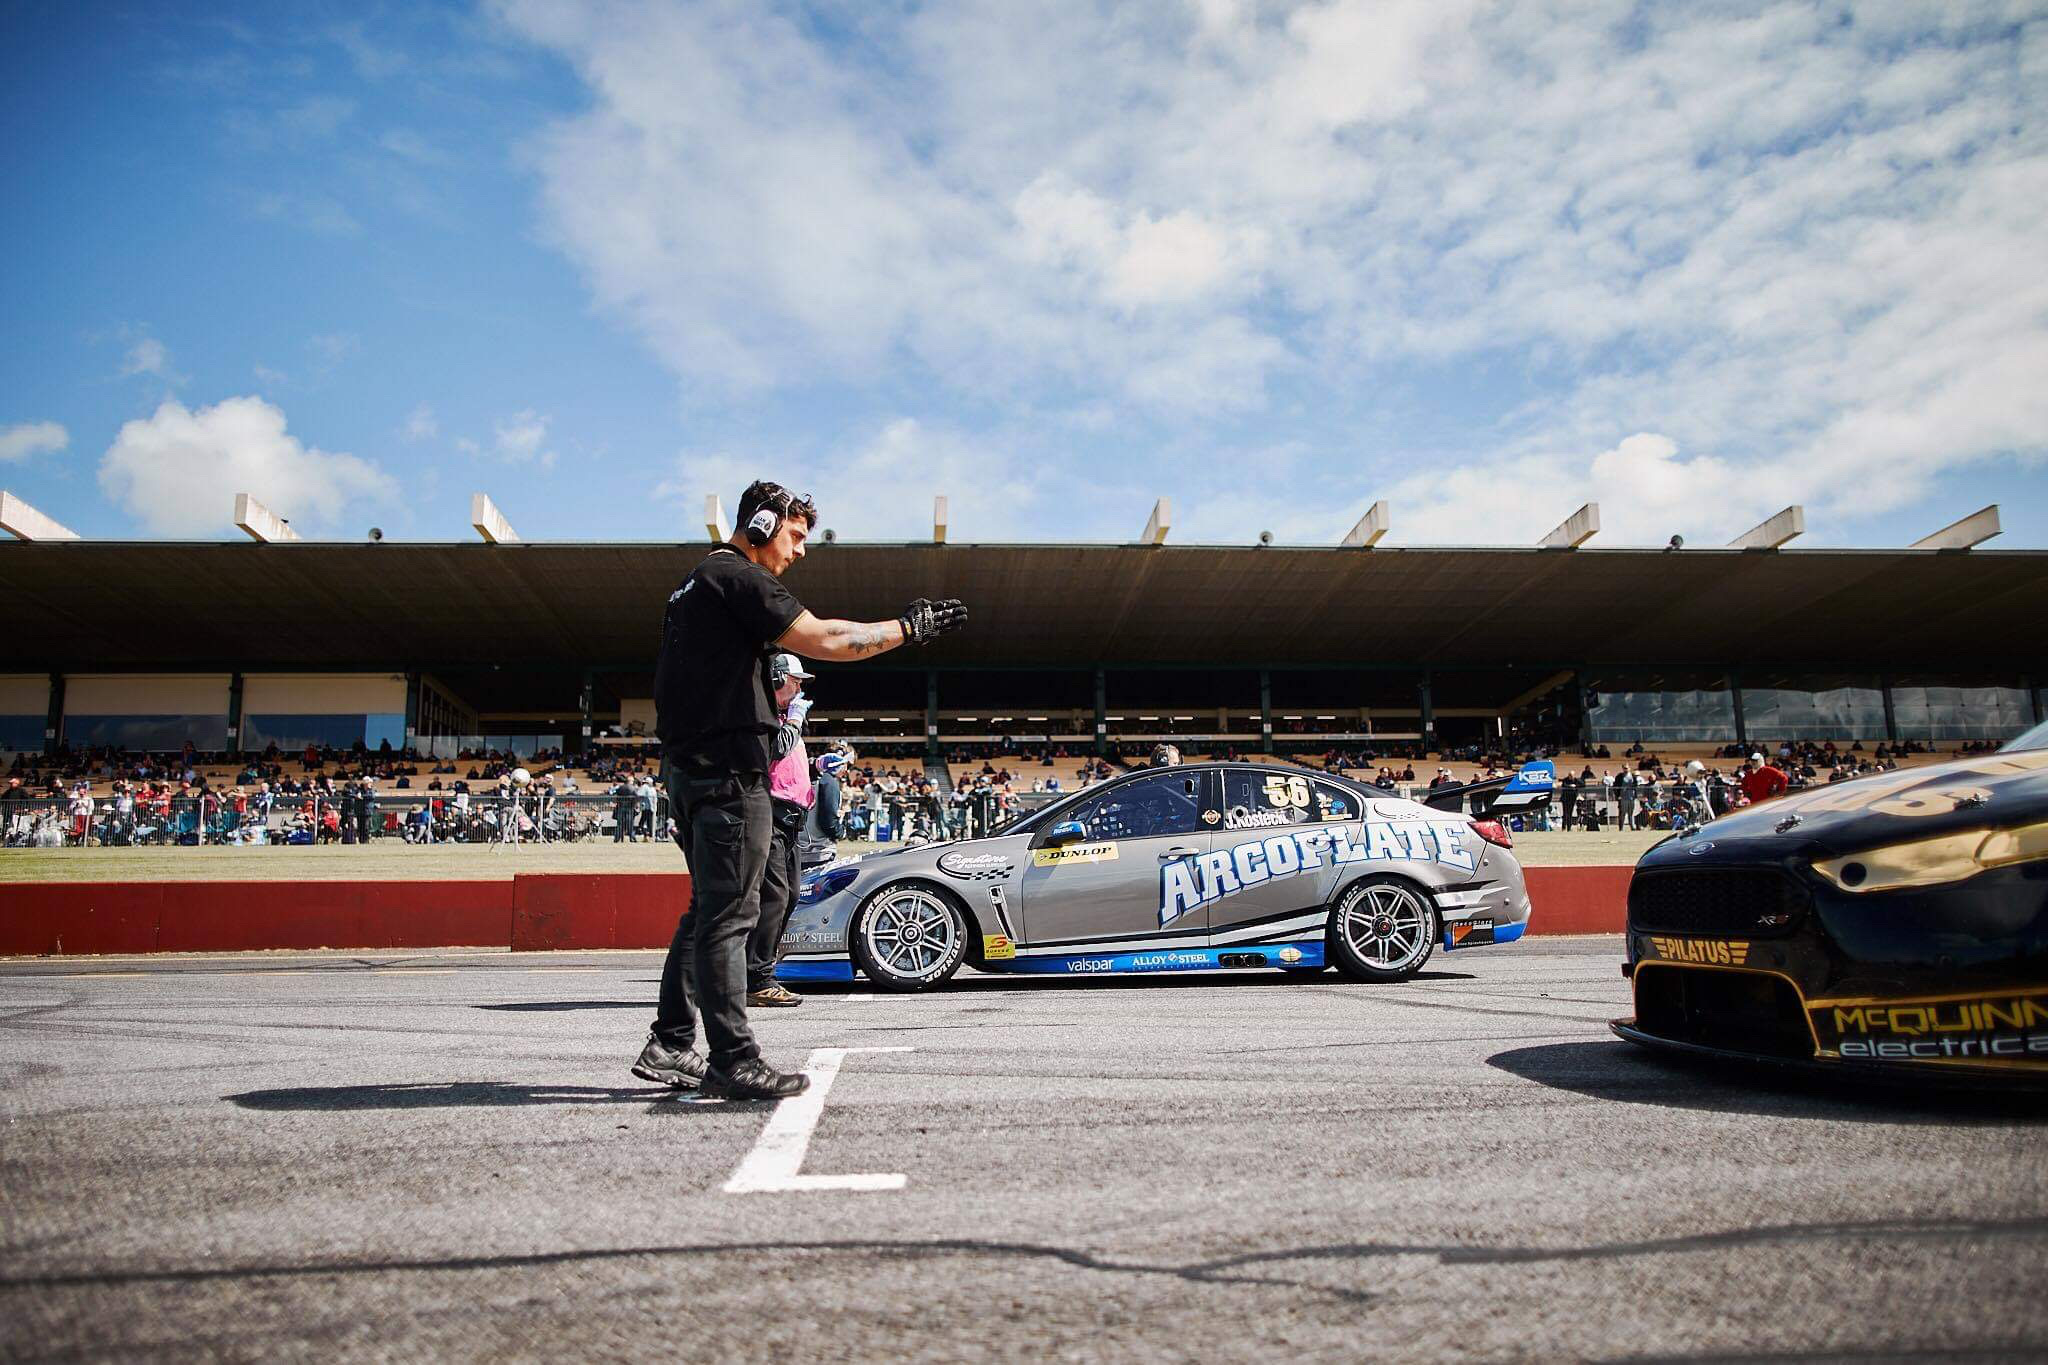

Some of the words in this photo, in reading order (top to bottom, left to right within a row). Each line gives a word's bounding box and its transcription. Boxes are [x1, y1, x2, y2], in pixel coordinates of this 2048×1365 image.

[1264, 776, 1311, 807] 56
[1048, 847, 1112, 859] DUNLOP
[1160, 821, 1475, 928] ARCOPLATE
[1337, 885, 1359, 933] DUNLOP
[811, 932, 842, 943] STEEL
[925, 938, 961, 983] DUNLOP
[1132, 955, 1167, 966] ALLOY
[1178, 953, 1210, 963] STEEL
[1665, 938, 1730, 963] PILATUS
[1067, 957, 1114, 972] valspar
